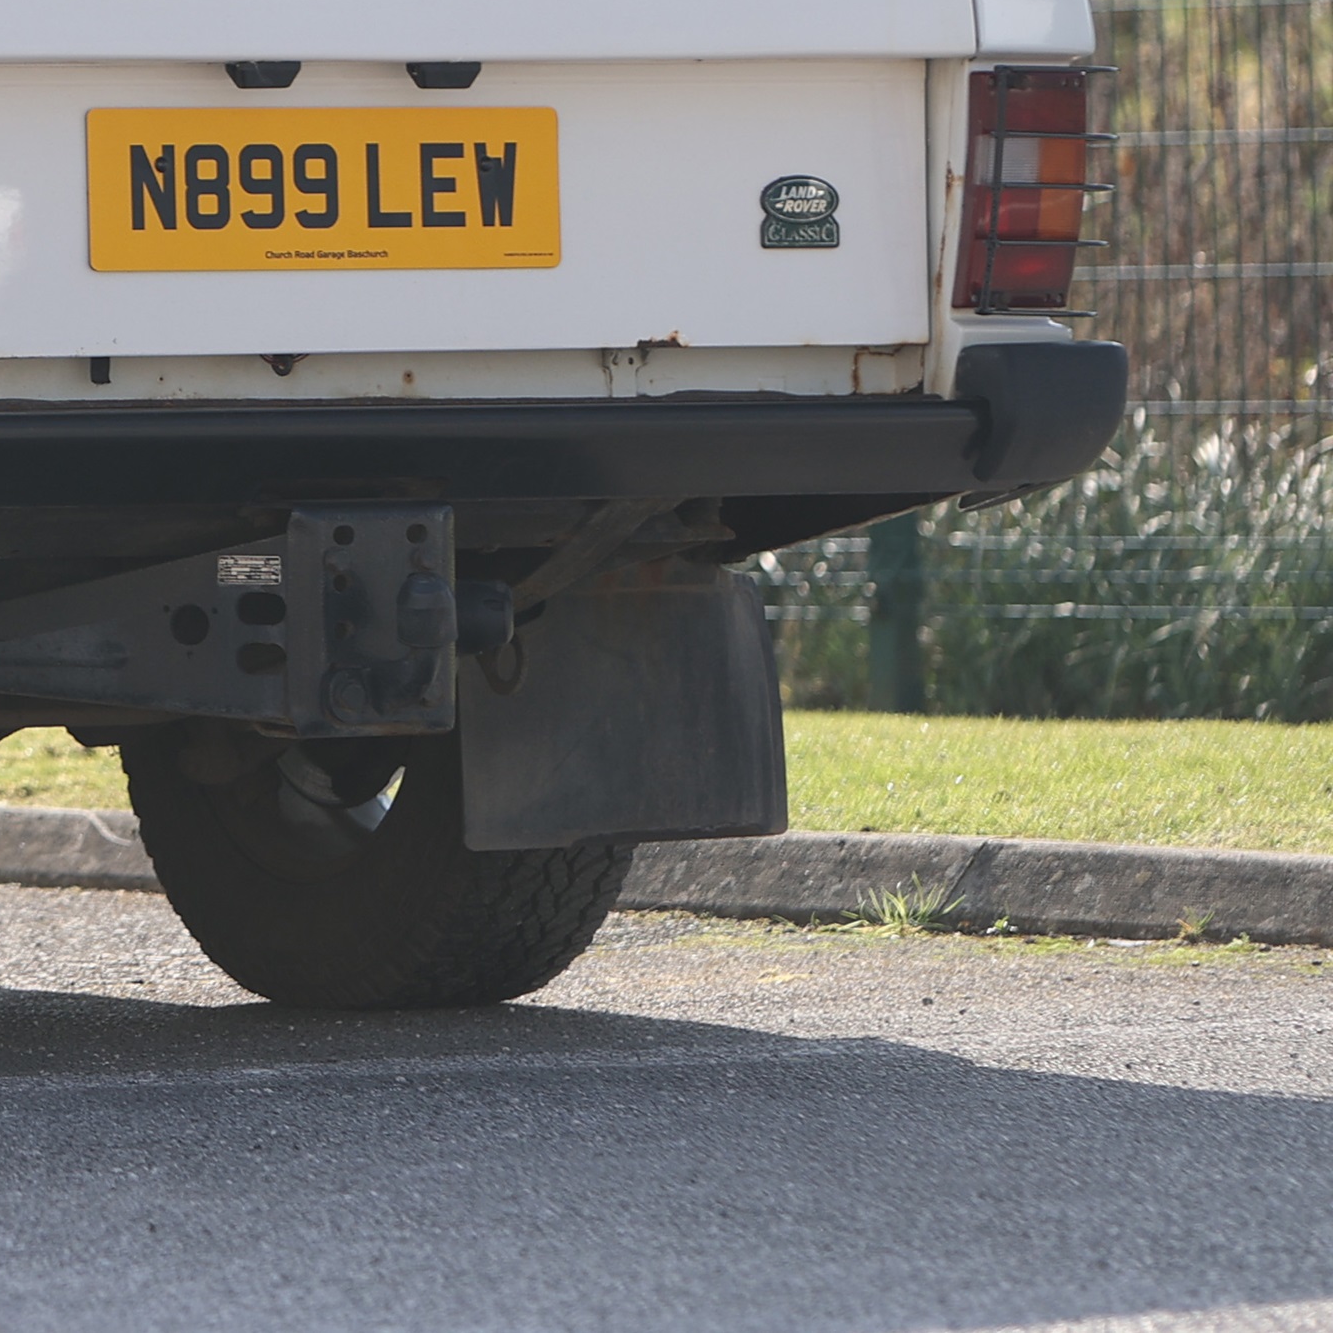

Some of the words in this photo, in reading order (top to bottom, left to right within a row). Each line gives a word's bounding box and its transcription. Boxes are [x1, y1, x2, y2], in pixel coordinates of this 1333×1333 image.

[129, 142, 340, 232] N899
[365, 141, 518, 229] LEW
[770, 185, 818, 200] LAND
[782, 199, 828, 213] ROVER
[768, 223, 835, 242] CLASSIC
[264, 250, 293, 259] Church
[294, 250, 315, 259] Road
[316, 250, 345, 260] Garage
